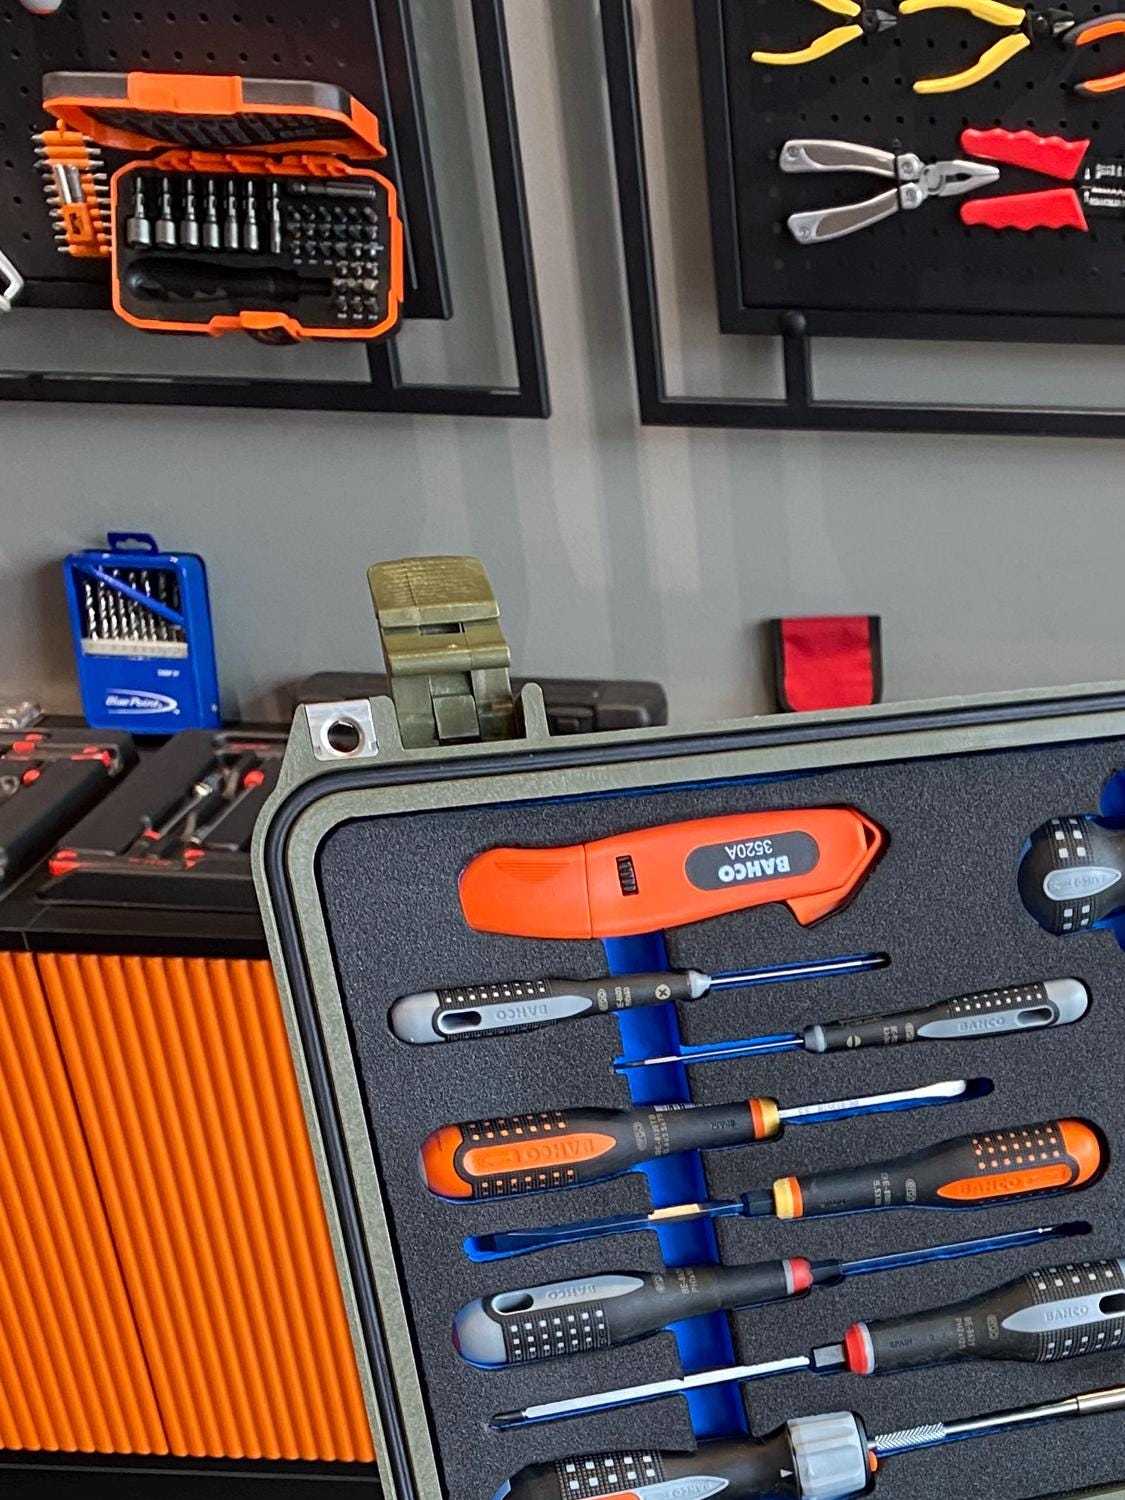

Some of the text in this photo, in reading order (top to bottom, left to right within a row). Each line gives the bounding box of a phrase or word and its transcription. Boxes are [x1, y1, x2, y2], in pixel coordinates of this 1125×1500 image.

[725, 840, 773, 860] 3520A
[718, 855, 791, 882] BAHCO
[496, 1004, 548, 1021] BAHCO
[957, 1013, 1006, 1032] BAHCO
[523, 1137, 594, 1162] BAHCO
[959, 1177, 1021, 1196] BAHCO
[544, 1284, 597, 1301] BAHCO
[1043, 1305, 1089, 1322] BAHCO
